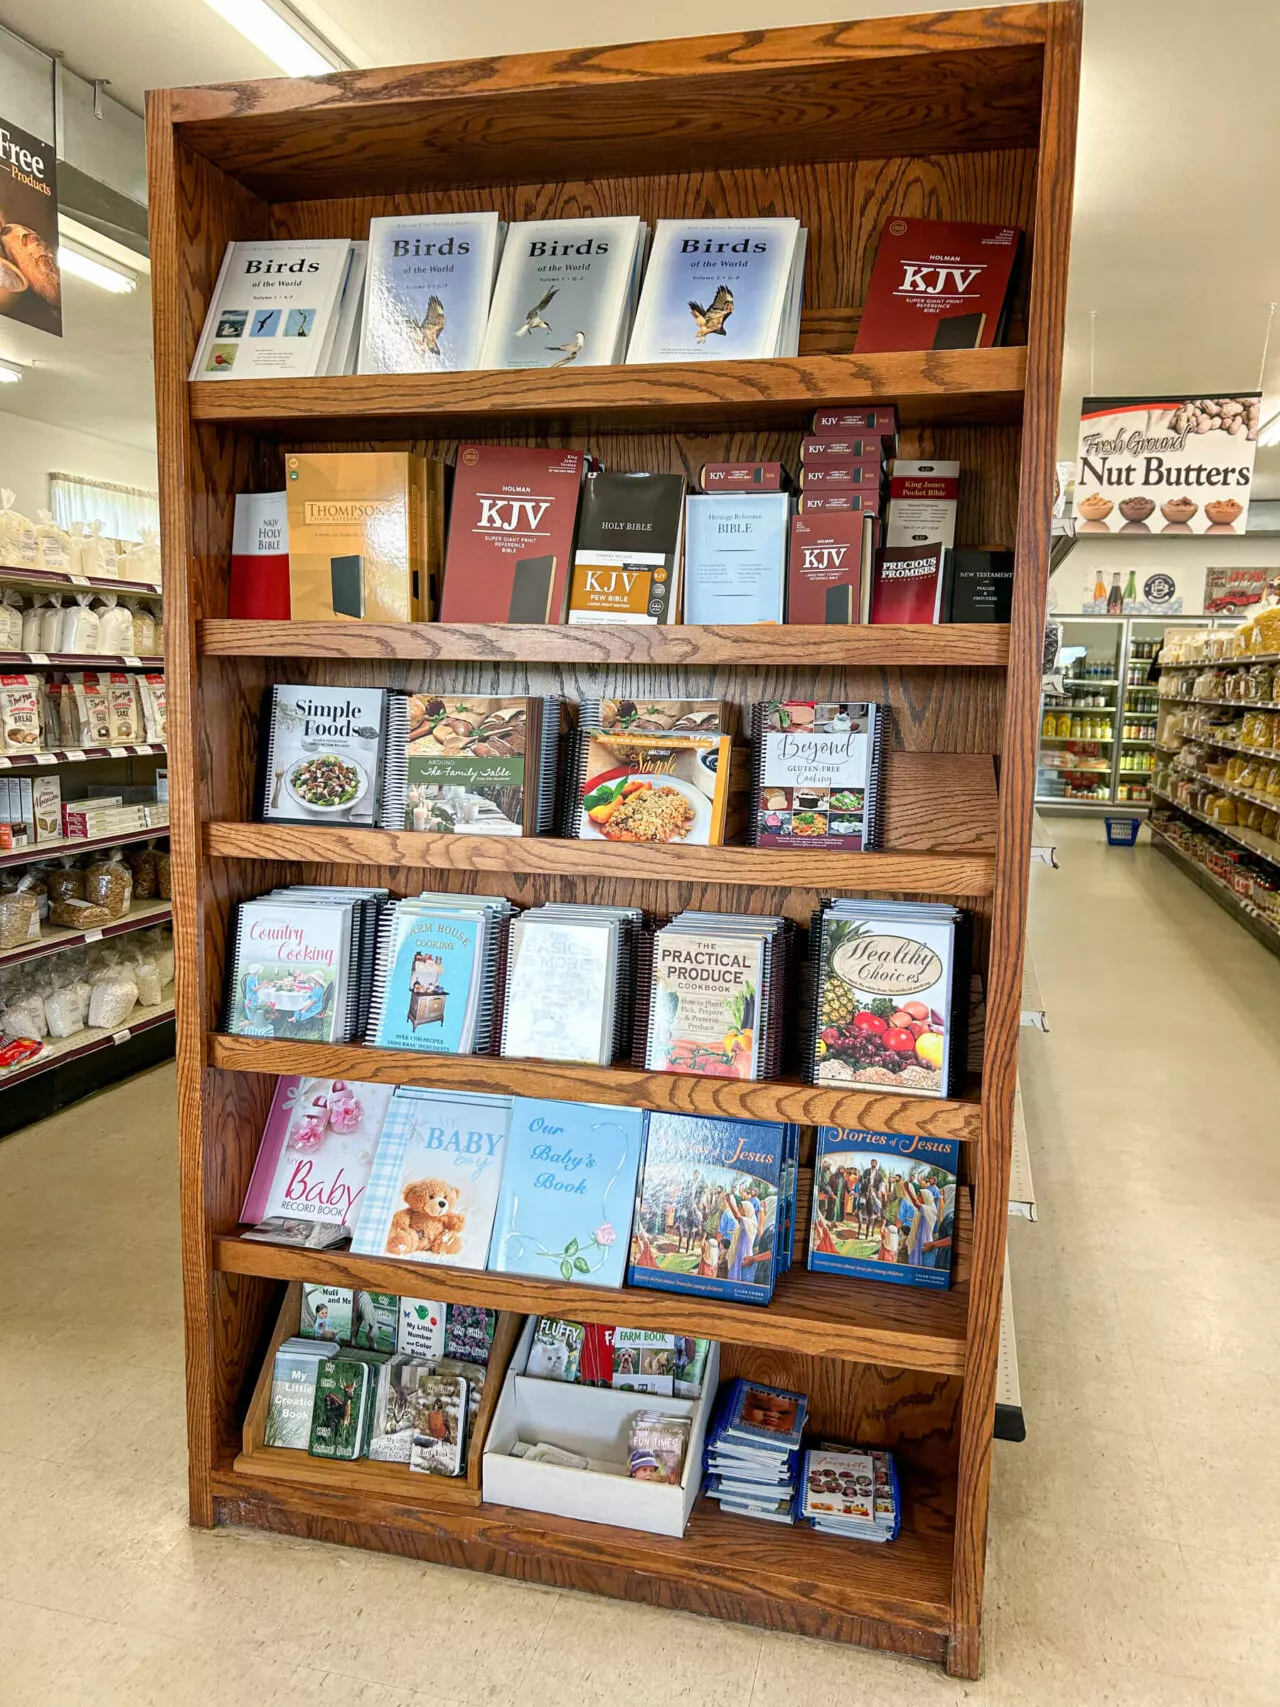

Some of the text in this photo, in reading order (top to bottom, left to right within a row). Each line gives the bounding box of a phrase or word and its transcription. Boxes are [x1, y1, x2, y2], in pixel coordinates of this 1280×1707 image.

[0, 127, 44, 178] Free
[11, 164, 52, 196] Products
[392, 236, 470, 257] Birds
[528, 238, 609, 257] Birds
[680, 238, 767, 254] Birds
[721, 260, 748, 268] World
[929, 254, 961, 262] HOLMAN
[244, 258, 320, 274] Birds
[414, 266, 426, 274] the
[430, 264, 454, 273] World
[548, 264, 561, 272] the
[565, 263, 591, 271] World
[252, 280, 261, 288] of
[898, 265, 982, 294] KJV
[821, 417, 838, 426] KJV
[1083, 424, 1193, 457] Fresh Ground
[809, 445, 825, 453] KJV
[709, 471, 726, 480] KJV
[808, 472, 824, 480] KJV
[1078, 456, 1250, 487] Nut Butters
[502, 485, 531, 493] HOLMAN
[905, 481, 922, 489] King
[307, 503, 385, 516] THOMPSON
[807, 500, 823, 508] KJV
[476, 498, 551, 531] KJV
[708, 512, 764, 521] Heritage Reference
[263, 519, 279, 528] NKJV
[601, 521, 653, 532] HOLY BIBLE
[718, 522, 753, 534] BIBLE
[259, 527, 281, 538] HOLY
[258, 539, 281, 550] BIBLE
[494, 541, 526, 549] REFERENCE
[802, 548, 847, 568] KJV
[882, 556, 937, 570] PRECIOUS
[880, 565, 937, 579] PROMISES
[584, 570, 639, 593] KJV
[607, 595, 629, 603] BIBLE
[116, 710, 130, 718] CAKE
[295, 699, 362, 722] Simple
[14, 714, 33, 724] BREAD
[304, 719, 361, 738] Foods
[777, 732, 856, 765] Beyond
[629, 751, 678, 779] Simple
[420, 765, 512, 782] The Family Table
[796, 771, 835, 788] Cooking
[250, 920, 304, 946] Country
[437, 923, 472, 948] HOUSE
[414, 938, 455, 951] COOKING
[696, 942, 717, 950] THE
[277, 942, 334, 967] Cooking
[662, 949, 752, 969] PRACTICAL
[845, 936, 936, 974] Healthy
[667, 965, 744, 985] PRODUCE
[857, 962, 922, 984] Choices
[678, 982, 731, 993] COOKBOOK
[681, 998, 697, 1006] How
[698, 1007, 724, 1017] Prepare
[691, 1015, 719, 1024] Preserve
[688, 1022, 715, 1032] Produce
[423, 1036, 444, 1045] RECIPES
[528, 1116, 565, 1136] Our
[425, 1127, 504, 1157] BABY
[828, 1126, 952, 1154] Stories of Jesus
[722, 1137, 775, 1165] Jesus
[285, 1157, 298, 1166] MY
[530, 1144, 598, 1172] Baby's
[452, 1151, 495, 1183] boy
[533, 1172, 588, 1195] Book
[284, 1159, 367, 1227] Baby
[280, 1201, 345, 1217] RECORD BOOK
[322, 1288, 340, 1296] Muff
[705, 1284, 724, 1293] children
[379, 1295, 390, 1306] My
[376, 1311, 392, 1320] Little
[406, 1322, 433, 1333] My Little
[454, 1326, 484, 1338] My Little
[540, 1319, 581, 1342] FLUFFY
[408, 1331, 432, 1341] Number
[620, 1331, 668, 1343] FARM BOOK
[415, 1341, 433, 1350] Color
[449, 1342, 489, 1357] Flower Book
[411, 1349, 427, 1357] Book
[325, 1362, 336, 1374] My
[291, 1370, 308, 1381] My
[285, 1383, 314, 1394] Little
[320, 1378, 337, 1388] Little
[275, 1394, 313, 1407] Creatio
[282, 1408, 309, 1419] Book
[316, 1427, 331, 1437] Wild
[633, 1436, 679, 1448] FUN TIMES
[312, 1444, 353, 1456] Animal Book
[817, 1456, 868, 1469] Favorite
